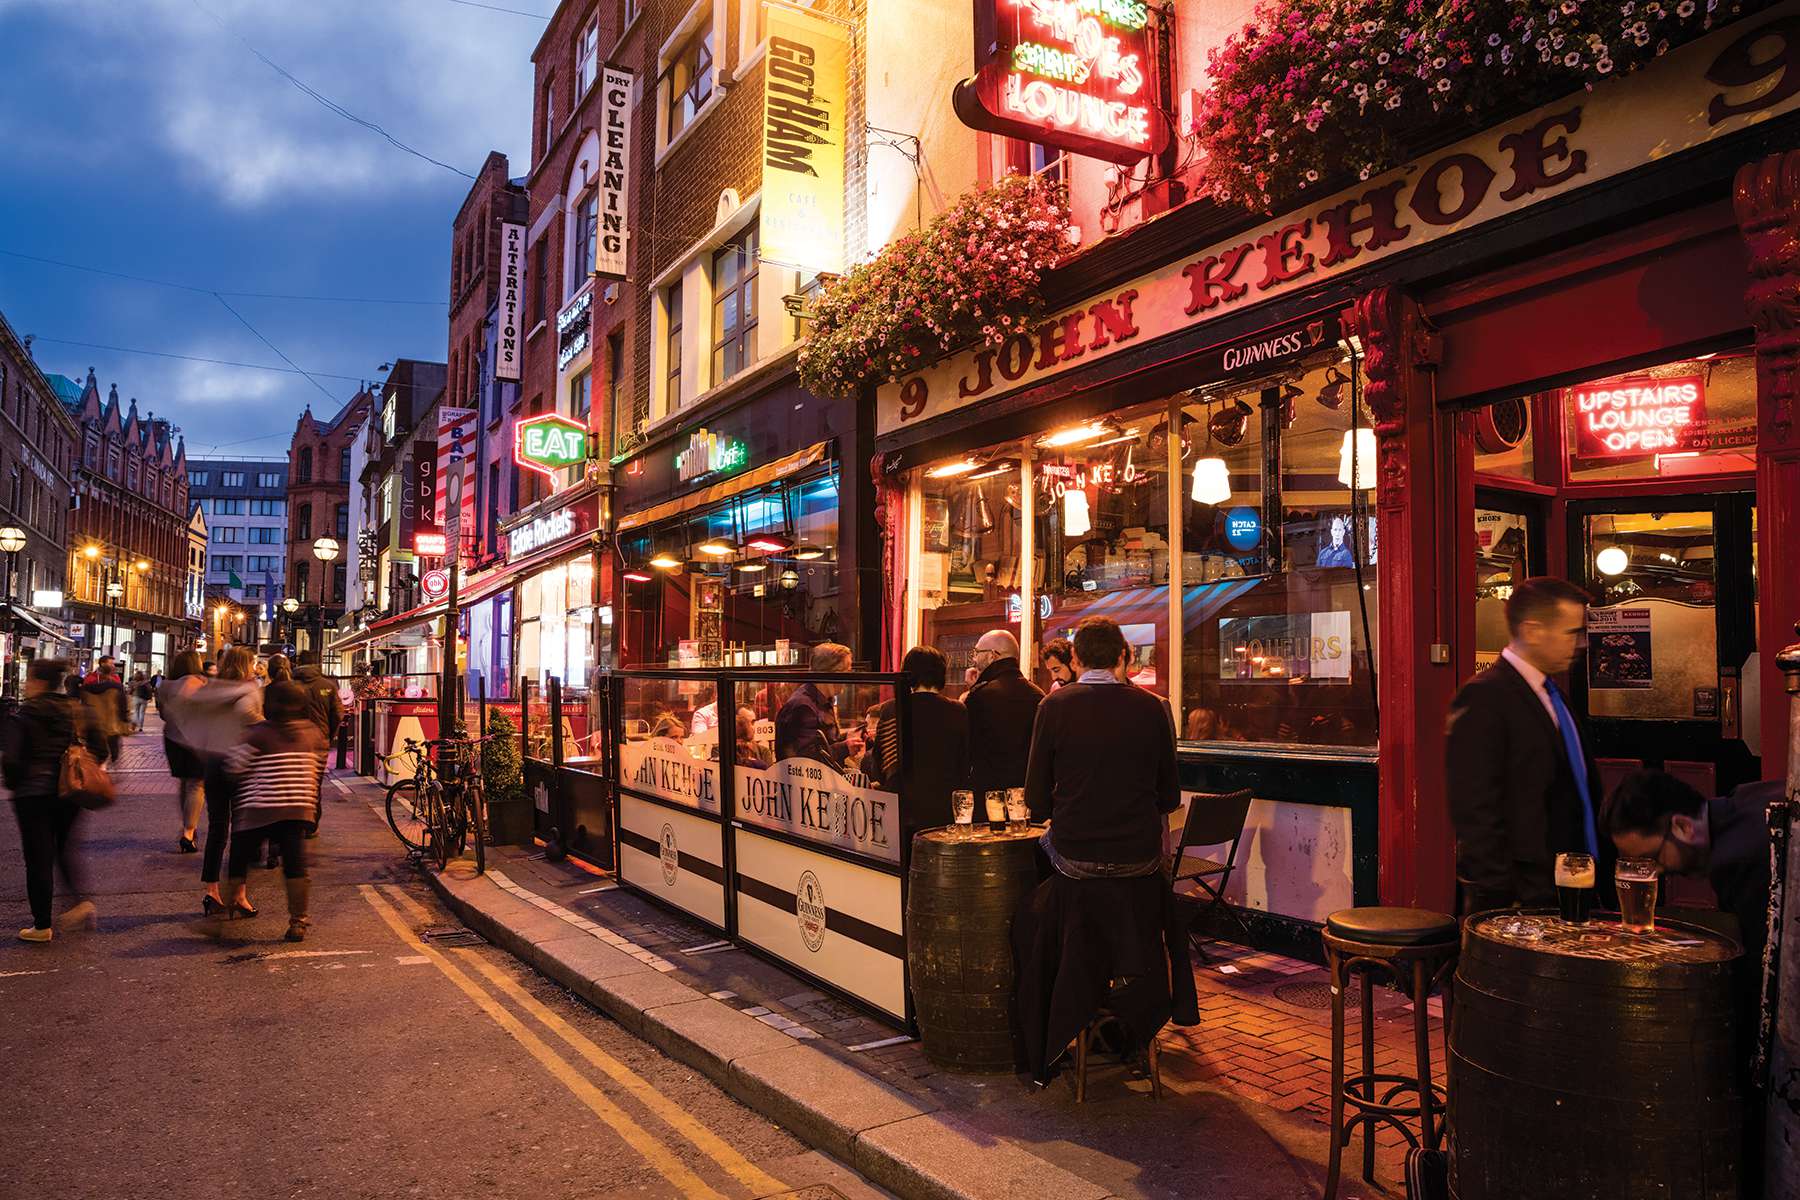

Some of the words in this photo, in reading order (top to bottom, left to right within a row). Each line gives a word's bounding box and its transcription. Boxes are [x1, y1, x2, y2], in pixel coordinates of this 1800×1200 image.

[606, 74, 630, 88] DRY
[766, 35, 836, 178] GOTHAM
[1005, 73, 1149, 143] LOUNGE
[603, 89, 626, 254] CLEANING
[900, 376, 929, 422] 9
[958, 288, 1140, 399] JOHN
[1182, 104, 1589, 317] KEHOE
[1704, 15, 1800, 127] 9
[503, 228, 519, 362] ALTERATIONS
[1223, 331, 1303, 371] GUINNESS
[1578, 383, 1697, 413] UPSTAIRS
[1588, 405, 1691, 431] LOUNGE
[525, 426, 583, 460] EAT
[1603, 427, 1678, 451] OPEN
[1693, 436, 1715, 448] DAY
[1718, 432, 1757, 446] LICENC
[420, 461, 432, 520] gbk
[787, 764, 804, 778] Estd.
[805, 767, 823, 781] 1803
[742, 775, 793, 821] JOHN
